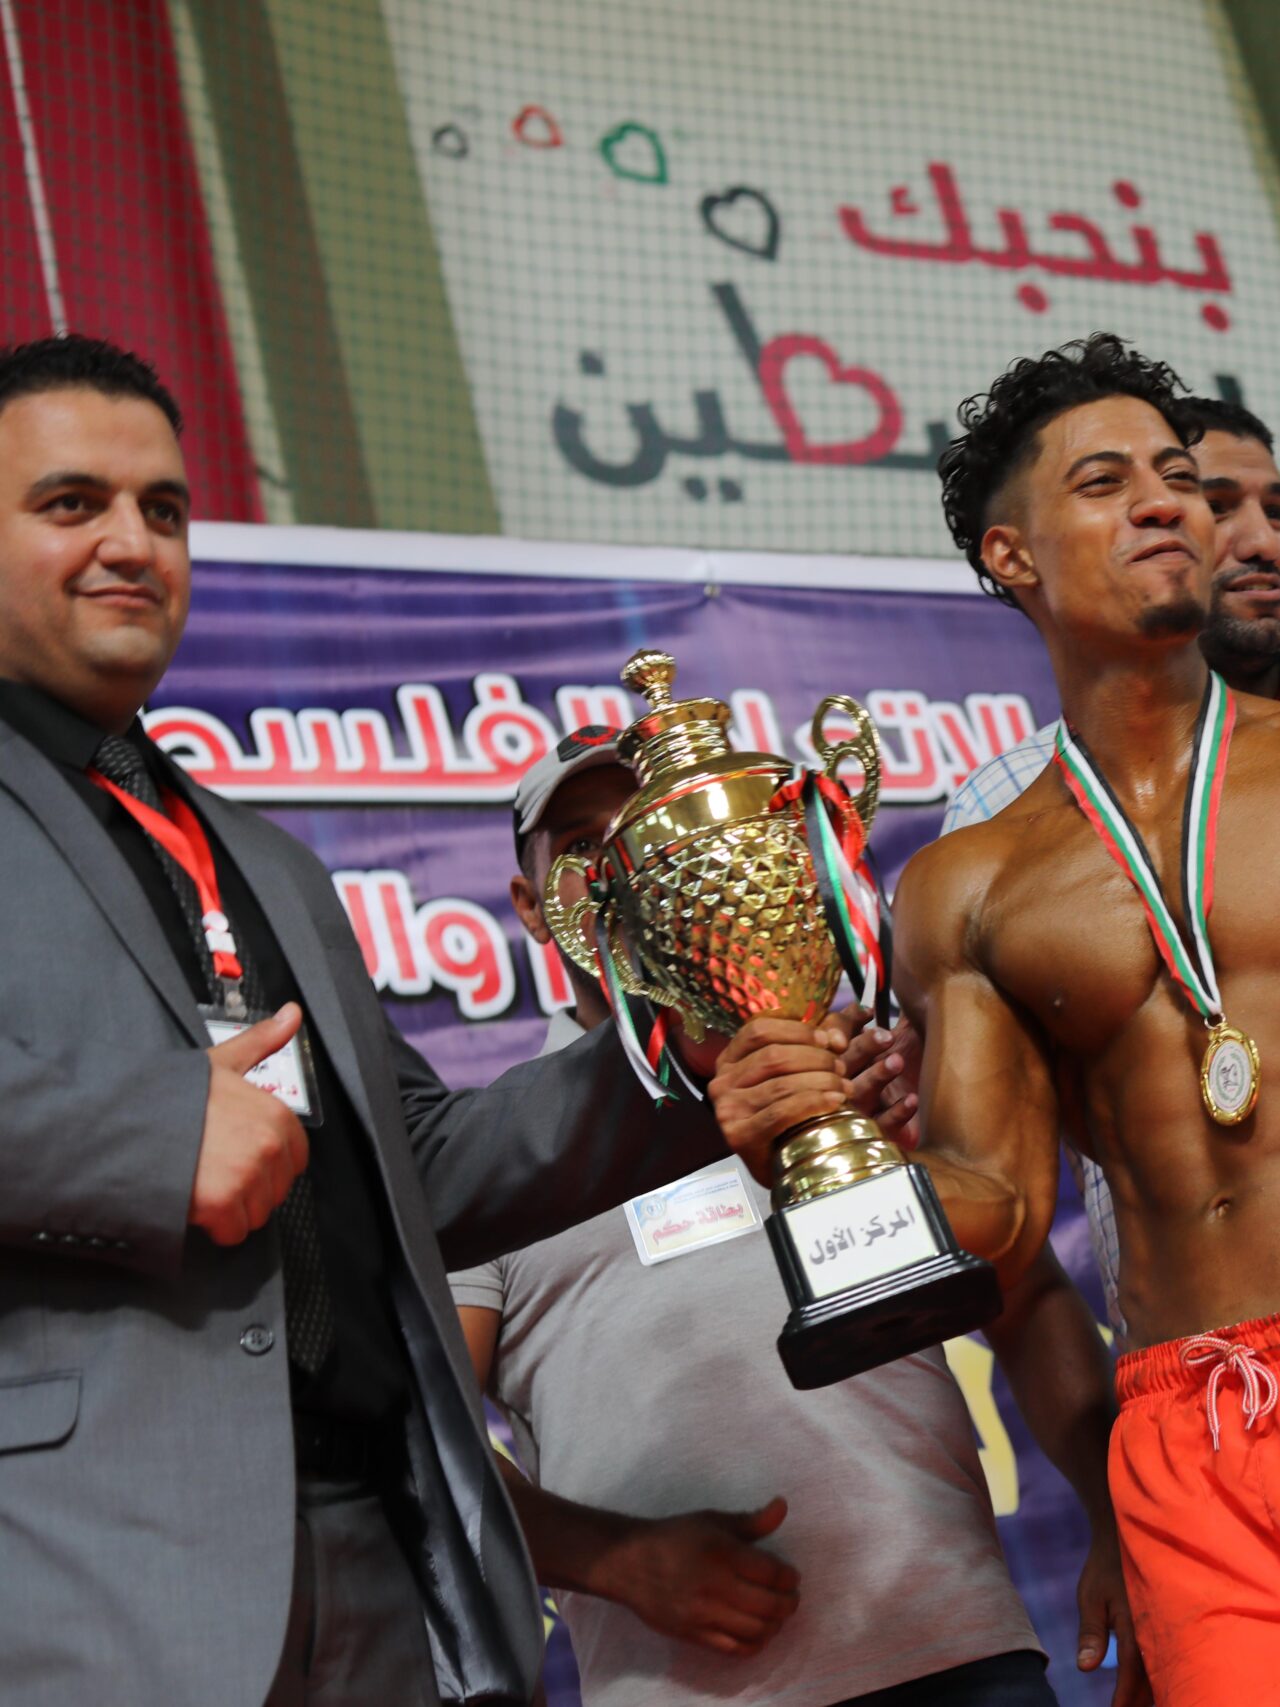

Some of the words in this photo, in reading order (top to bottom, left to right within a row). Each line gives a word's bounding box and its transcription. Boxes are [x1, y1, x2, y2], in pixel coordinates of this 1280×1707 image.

[838, 162, 1232, 332] بنحبك
[808, 1226, 857, 1266] الأول
[859, 1204, 916, 1247] المركز
